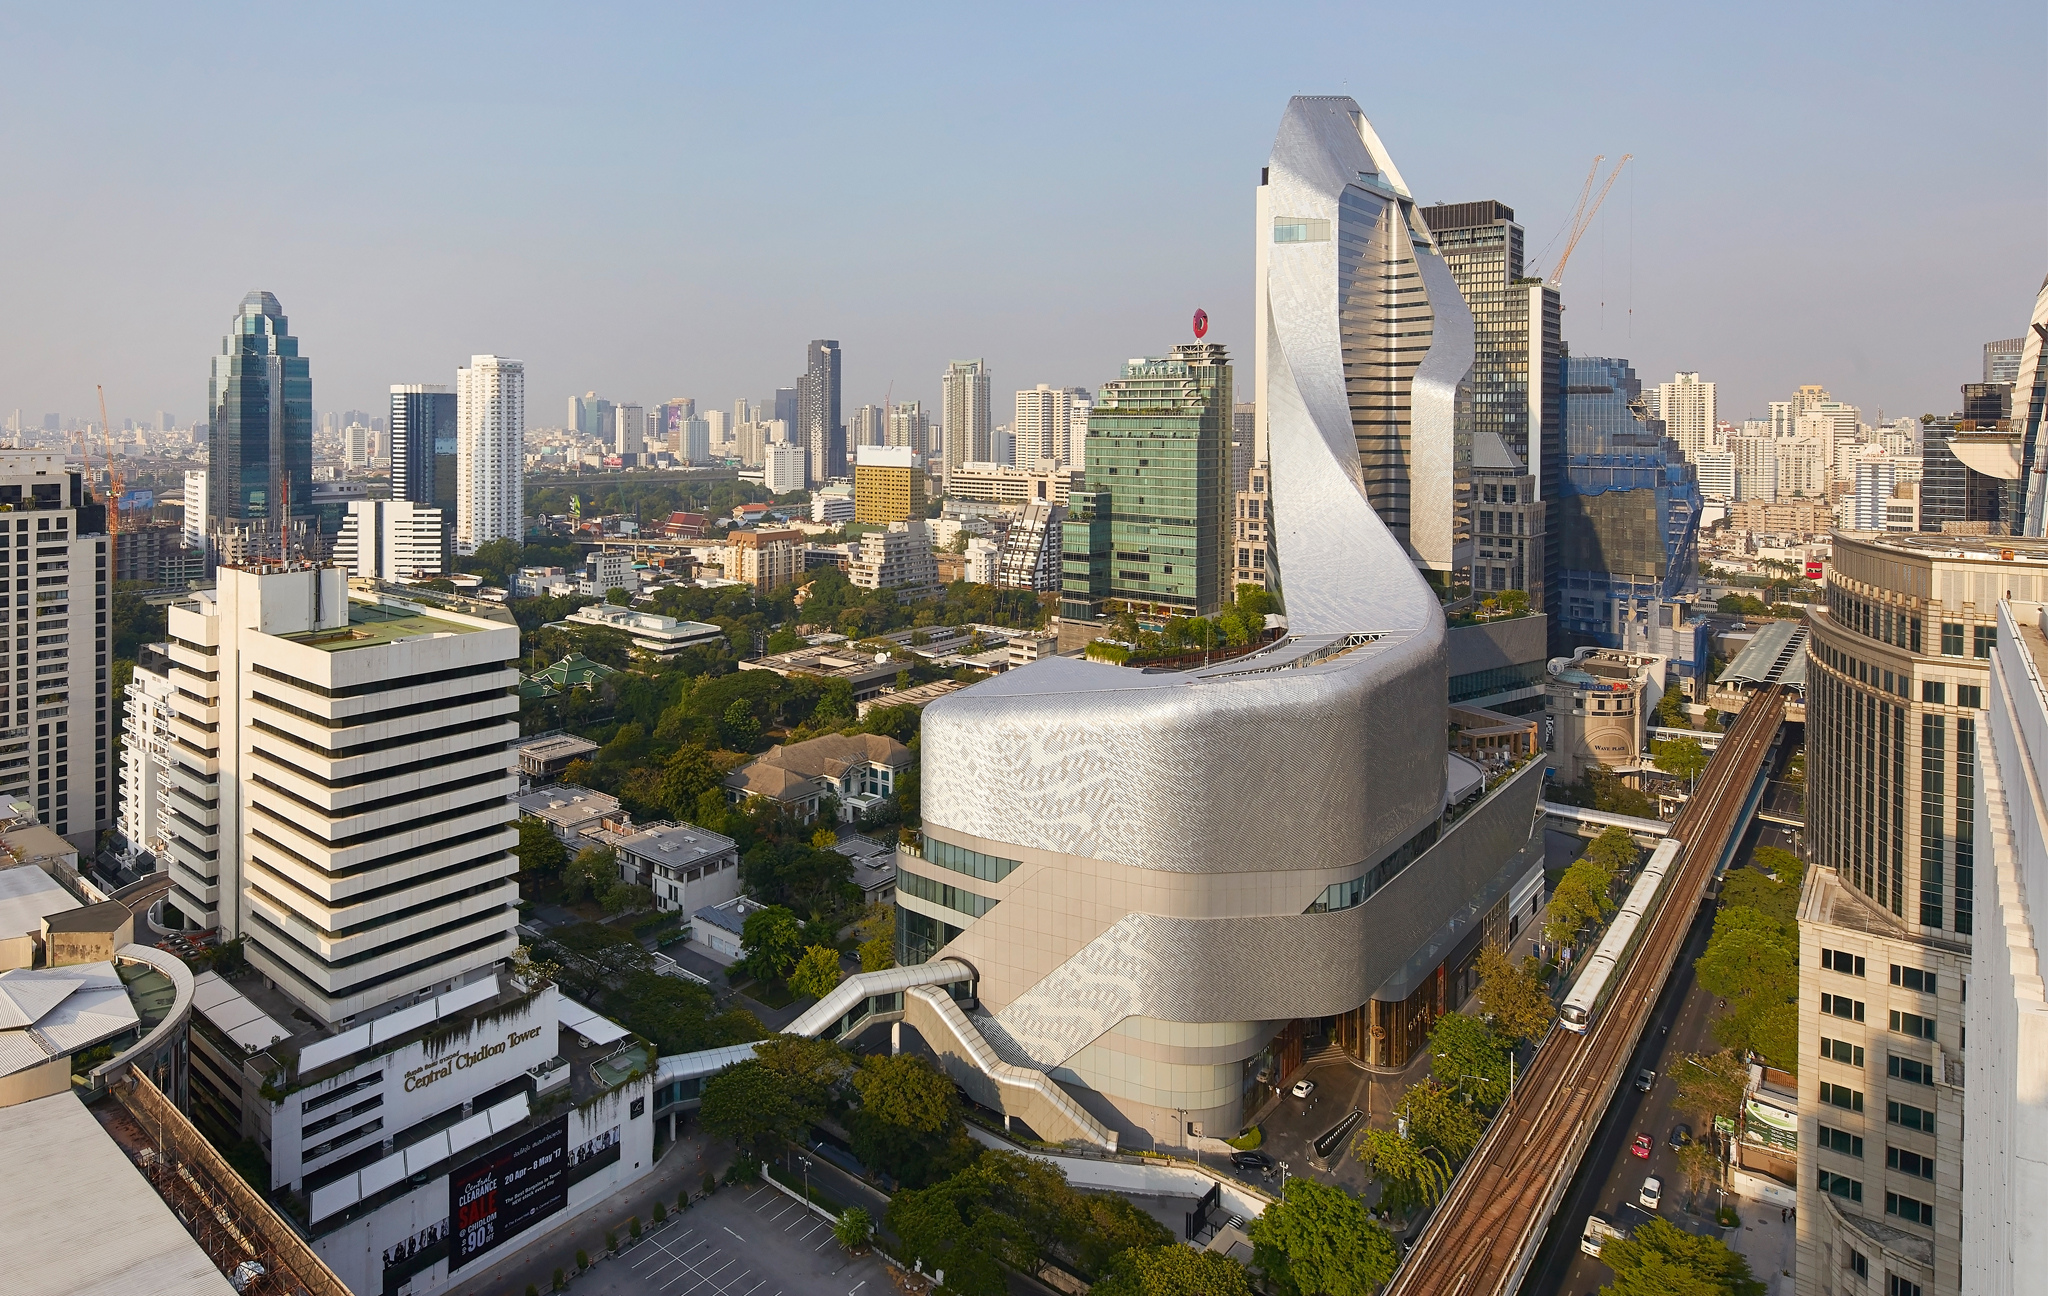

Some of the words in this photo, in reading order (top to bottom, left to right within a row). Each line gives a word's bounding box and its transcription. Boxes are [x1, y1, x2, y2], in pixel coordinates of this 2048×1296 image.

[1128, 365, 1183, 376] SIVATEL
[404, 1060, 453, 1093] Central
[455, 1041, 506, 1071] Chidlom
[507, 1026, 542, 1049] Tower
[504, 1172, 514, 1185] 20
[515, 1167, 527, 1180] Apr
[533, 1160, 538, 1169] 8
[539, 1153, 553, 1167] May
[459, 1178, 497, 1207] CLEARANCE
[464, 1172, 492, 1194] Central
[458, 1189, 498, 1230] SALE
[467, 1211, 497, 1233] CHIDLOM
[485, 1232, 495, 1243] OFF
